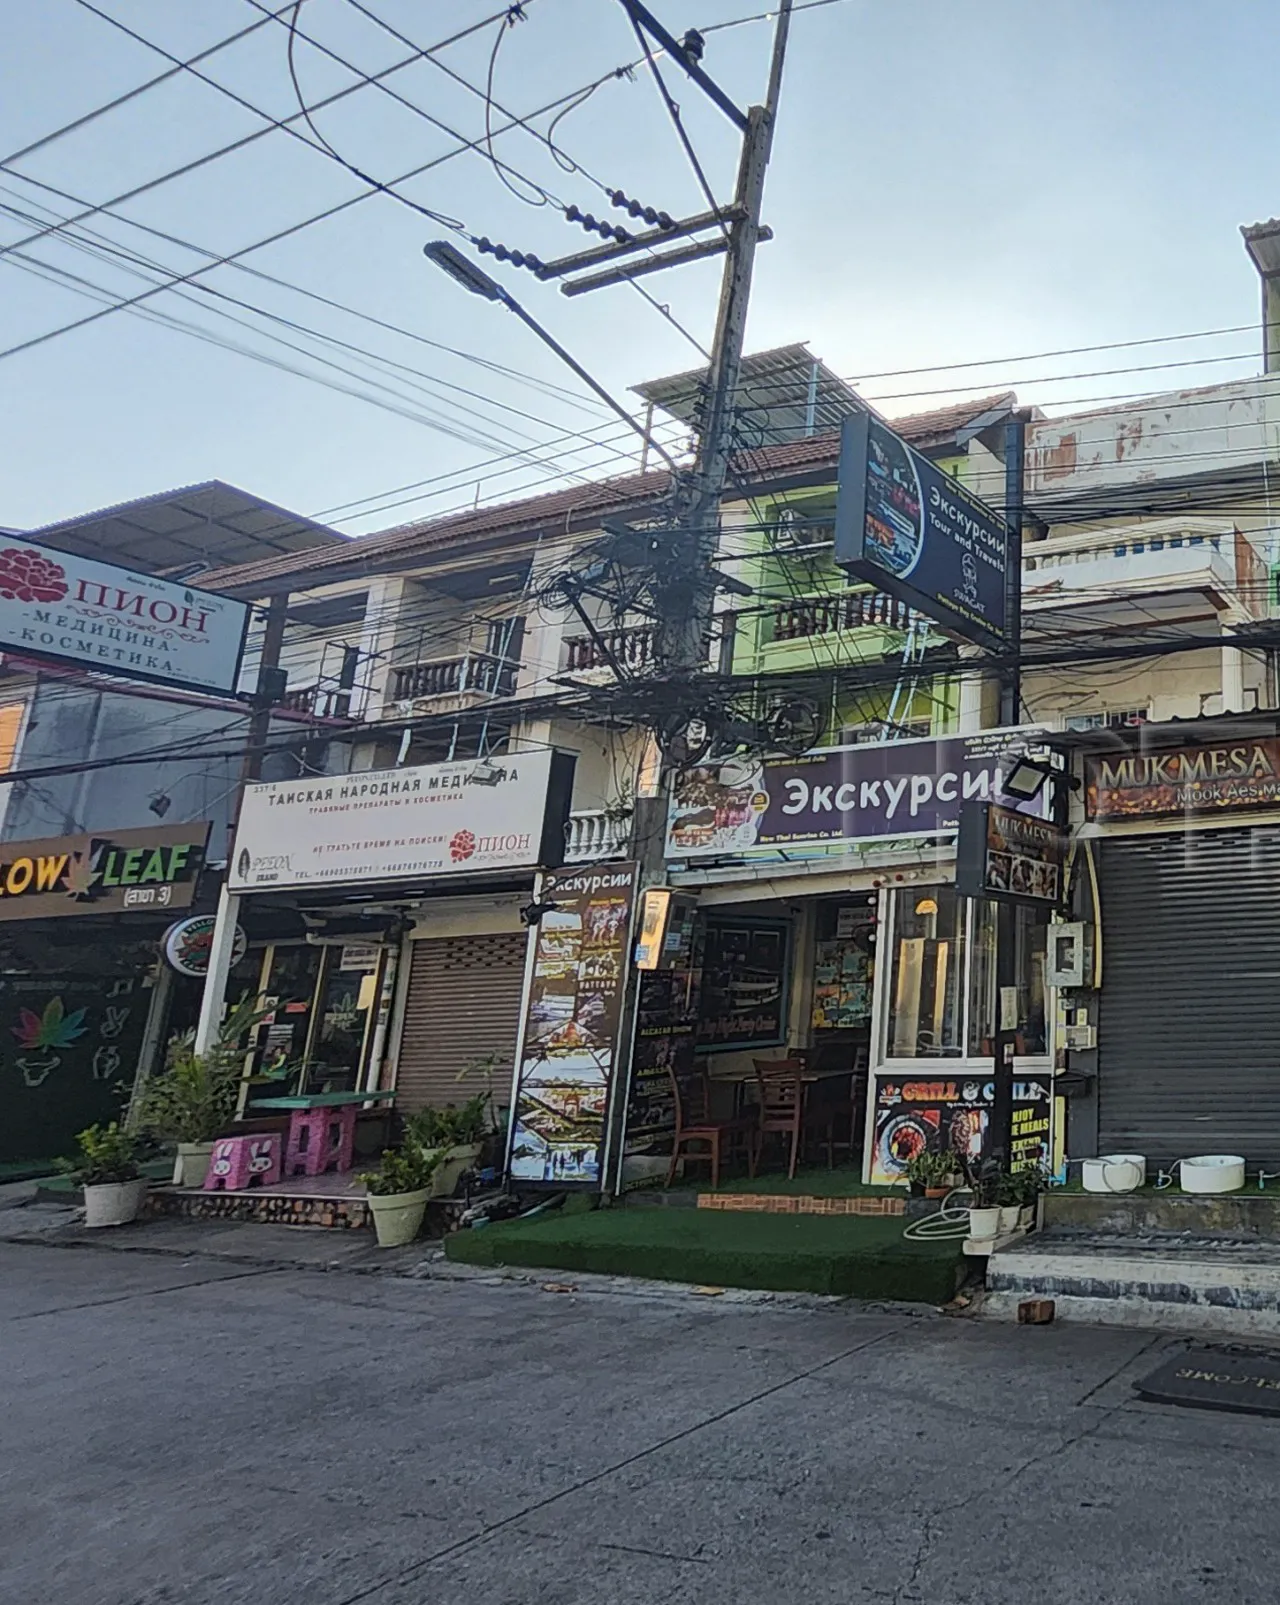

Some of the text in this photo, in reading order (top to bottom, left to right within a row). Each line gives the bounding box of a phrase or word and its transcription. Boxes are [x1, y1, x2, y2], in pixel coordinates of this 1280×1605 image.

[930, 486, 1005, 555] Экскурсии
[929, 511, 1005, 573] Tour and Travels
[73, 578, 210, 633] ПИОН
[340, 777, 421, 798] НАРОДНАЯ
[782, 768, 1003, 820] Экскурси
[1177, 786, 1221, 803] Mook
[413, 793, 464, 804] КОСМЕТИКА
[477, 834, 532, 853] ПИОН
[776, 833, 791, 841] Thai
[0, 843, 192, 896] OW LEAF
[157, 885, 172, 906] 3)
[186, 919, 214, 933] YELLO
[901, 1081, 960, 1101] GRILL
[962, 1081, 981, 1101] &
[1020, 1118, 1049, 1135] MEALS
